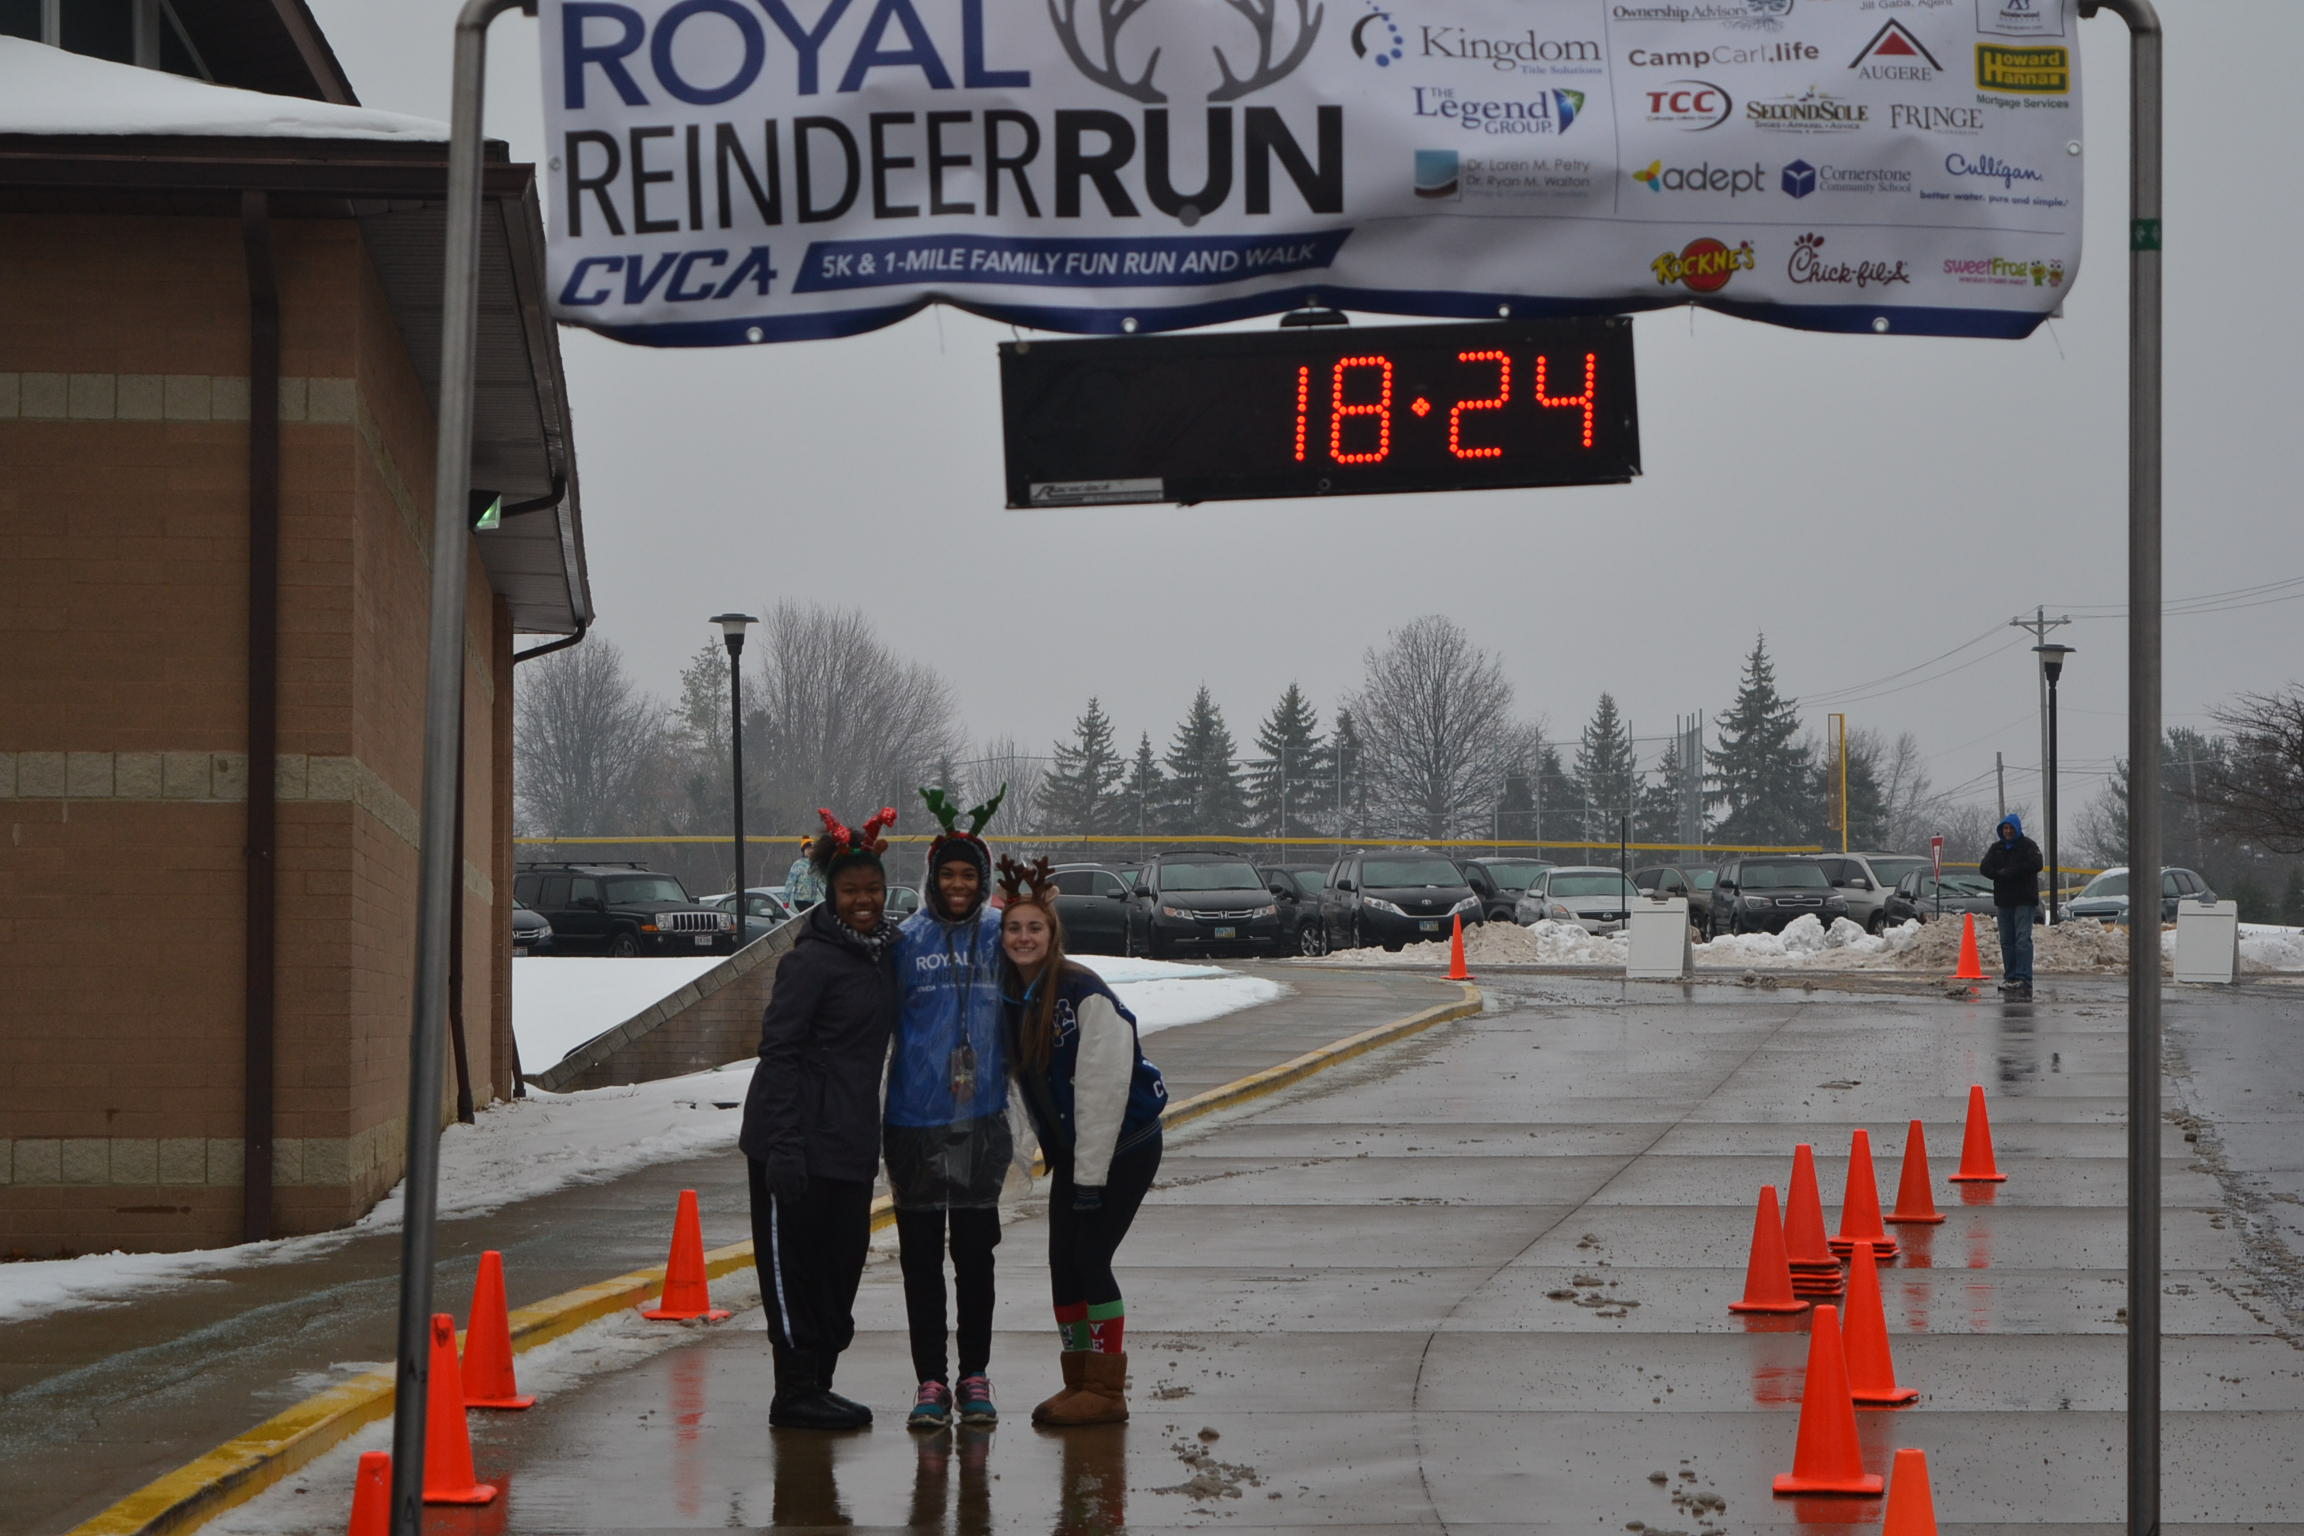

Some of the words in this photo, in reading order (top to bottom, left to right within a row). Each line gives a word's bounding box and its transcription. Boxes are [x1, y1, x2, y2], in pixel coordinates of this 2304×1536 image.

[1613, 5, 1690, 22] Ownership
[1691, 5, 1748, 18] Advisors
[562, 0, 1031, 110] ROYAL
[1419, 25, 1602, 72] Kingdom
[1858, 65, 1933, 81] AUGERE
[1431, 87, 1455, 98] THE
[1646, 91, 1715, 113] TCC
[1976, 94, 2021, 109] Mortgage
[2023, 97, 2069, 109] Services
[1412, 86, 1551, 129] Legend
[1889, 104, 1984, 130] FRINGE
[1466, 158, 1485, 172] Dr.
[1489, 159, 1529, 172] Loren
[1820, 165, 1912, 181] Cornerstone
[1663, 161, 1766, 198] adept
[1819, 181, 1875, 195] Community
[1877, 182, 1912, 193] School
[1920, 190, 1950, 200] better
[822, 250, 853, 278] 5K
[857, 253, 876, 276] &
[884, 248, 965, 273] 1-MILE
[970, 248, 1062, 276] FAMILY
[1065, 251, 1119, 276] FUN
[1123, 250, 1178, 275] RUN
[1180, 249, 1240, 273] AND
[1244, 243, 1317, 268] WALK
[559, 246, 778, 306] CVCA
